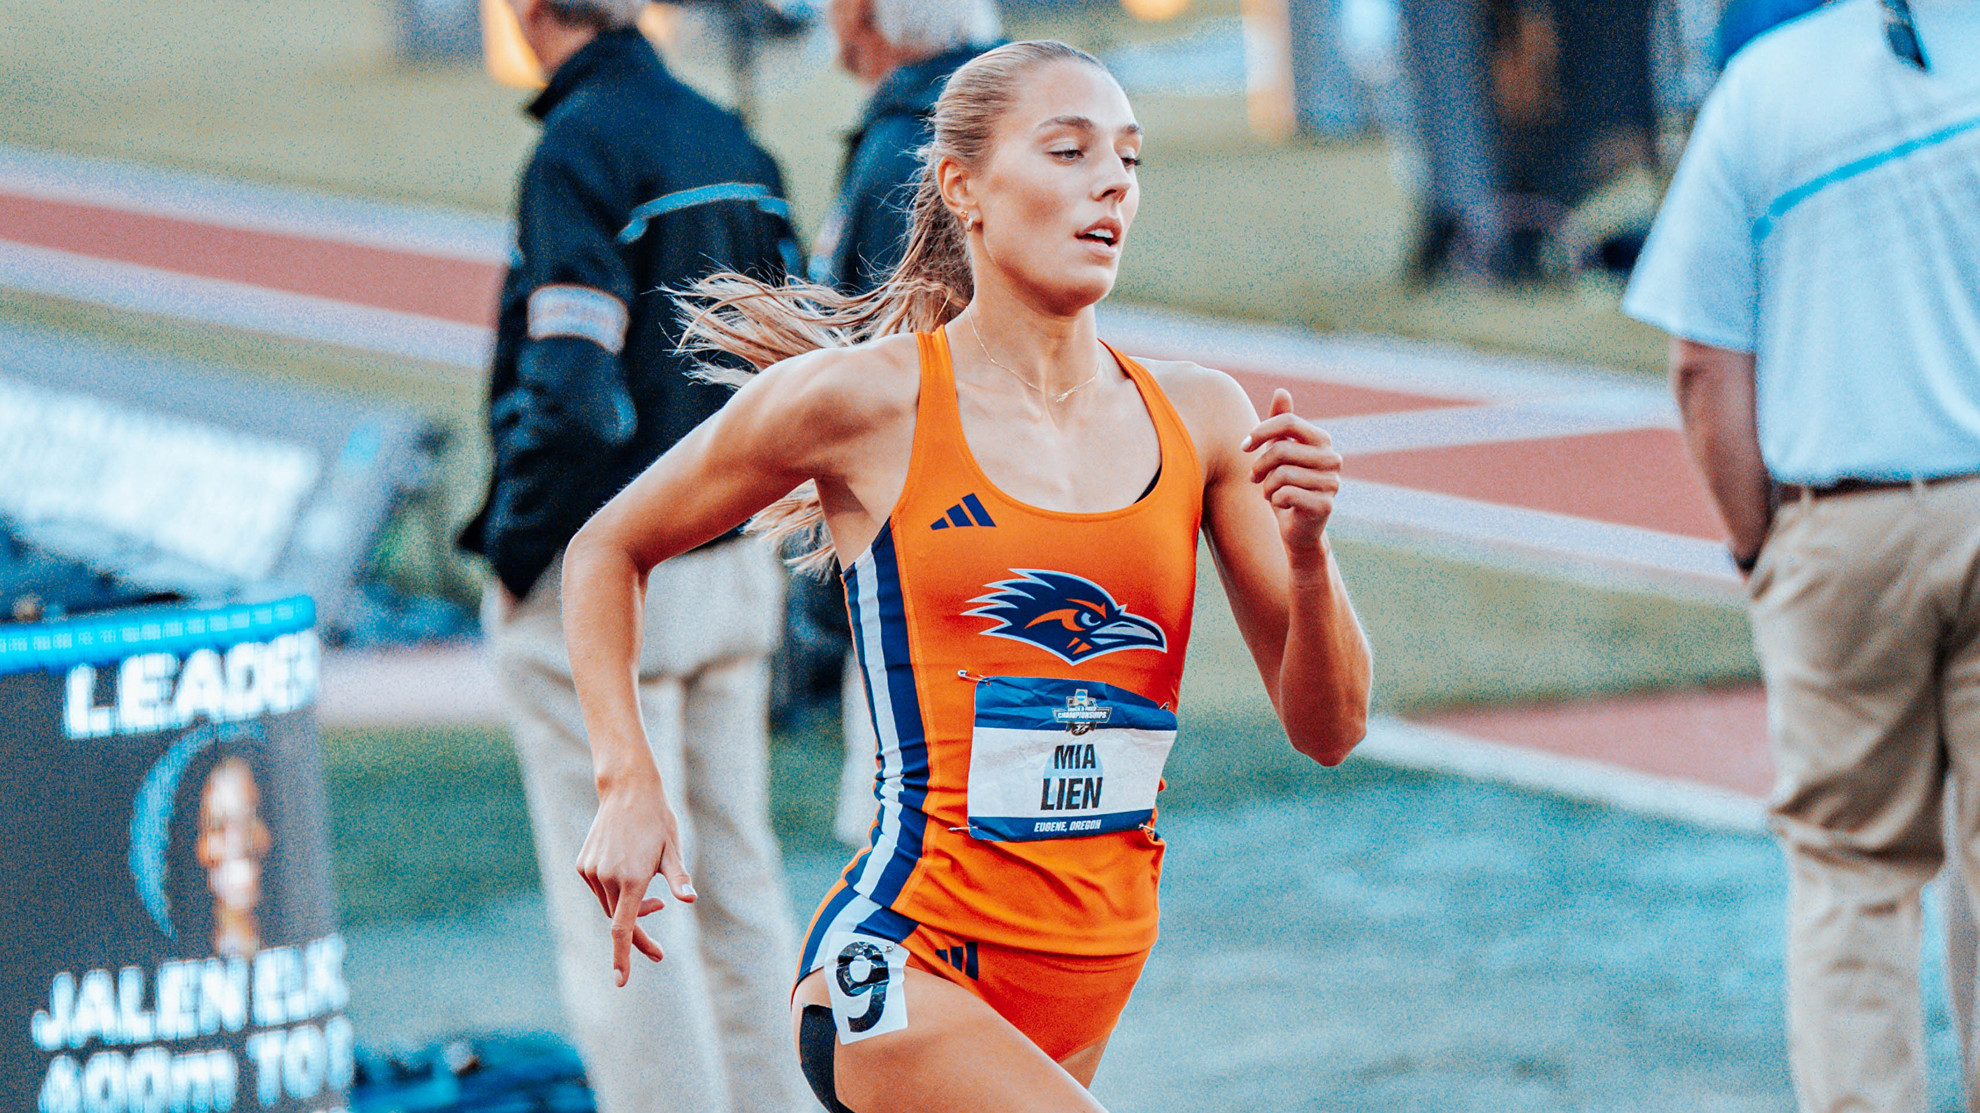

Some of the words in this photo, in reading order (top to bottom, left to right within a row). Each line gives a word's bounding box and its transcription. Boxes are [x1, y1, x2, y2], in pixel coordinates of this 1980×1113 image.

[1054, 744, 1097, 769] MIA
[1040, 776, 1104, 810] LIEN
[1034, 821, 1068, 832] EUGENE,
[1069, 819, 1102, 831] OREGON
[31, 955, 249, 1050] JALEN
[835, 941, 890, 1033] 9
